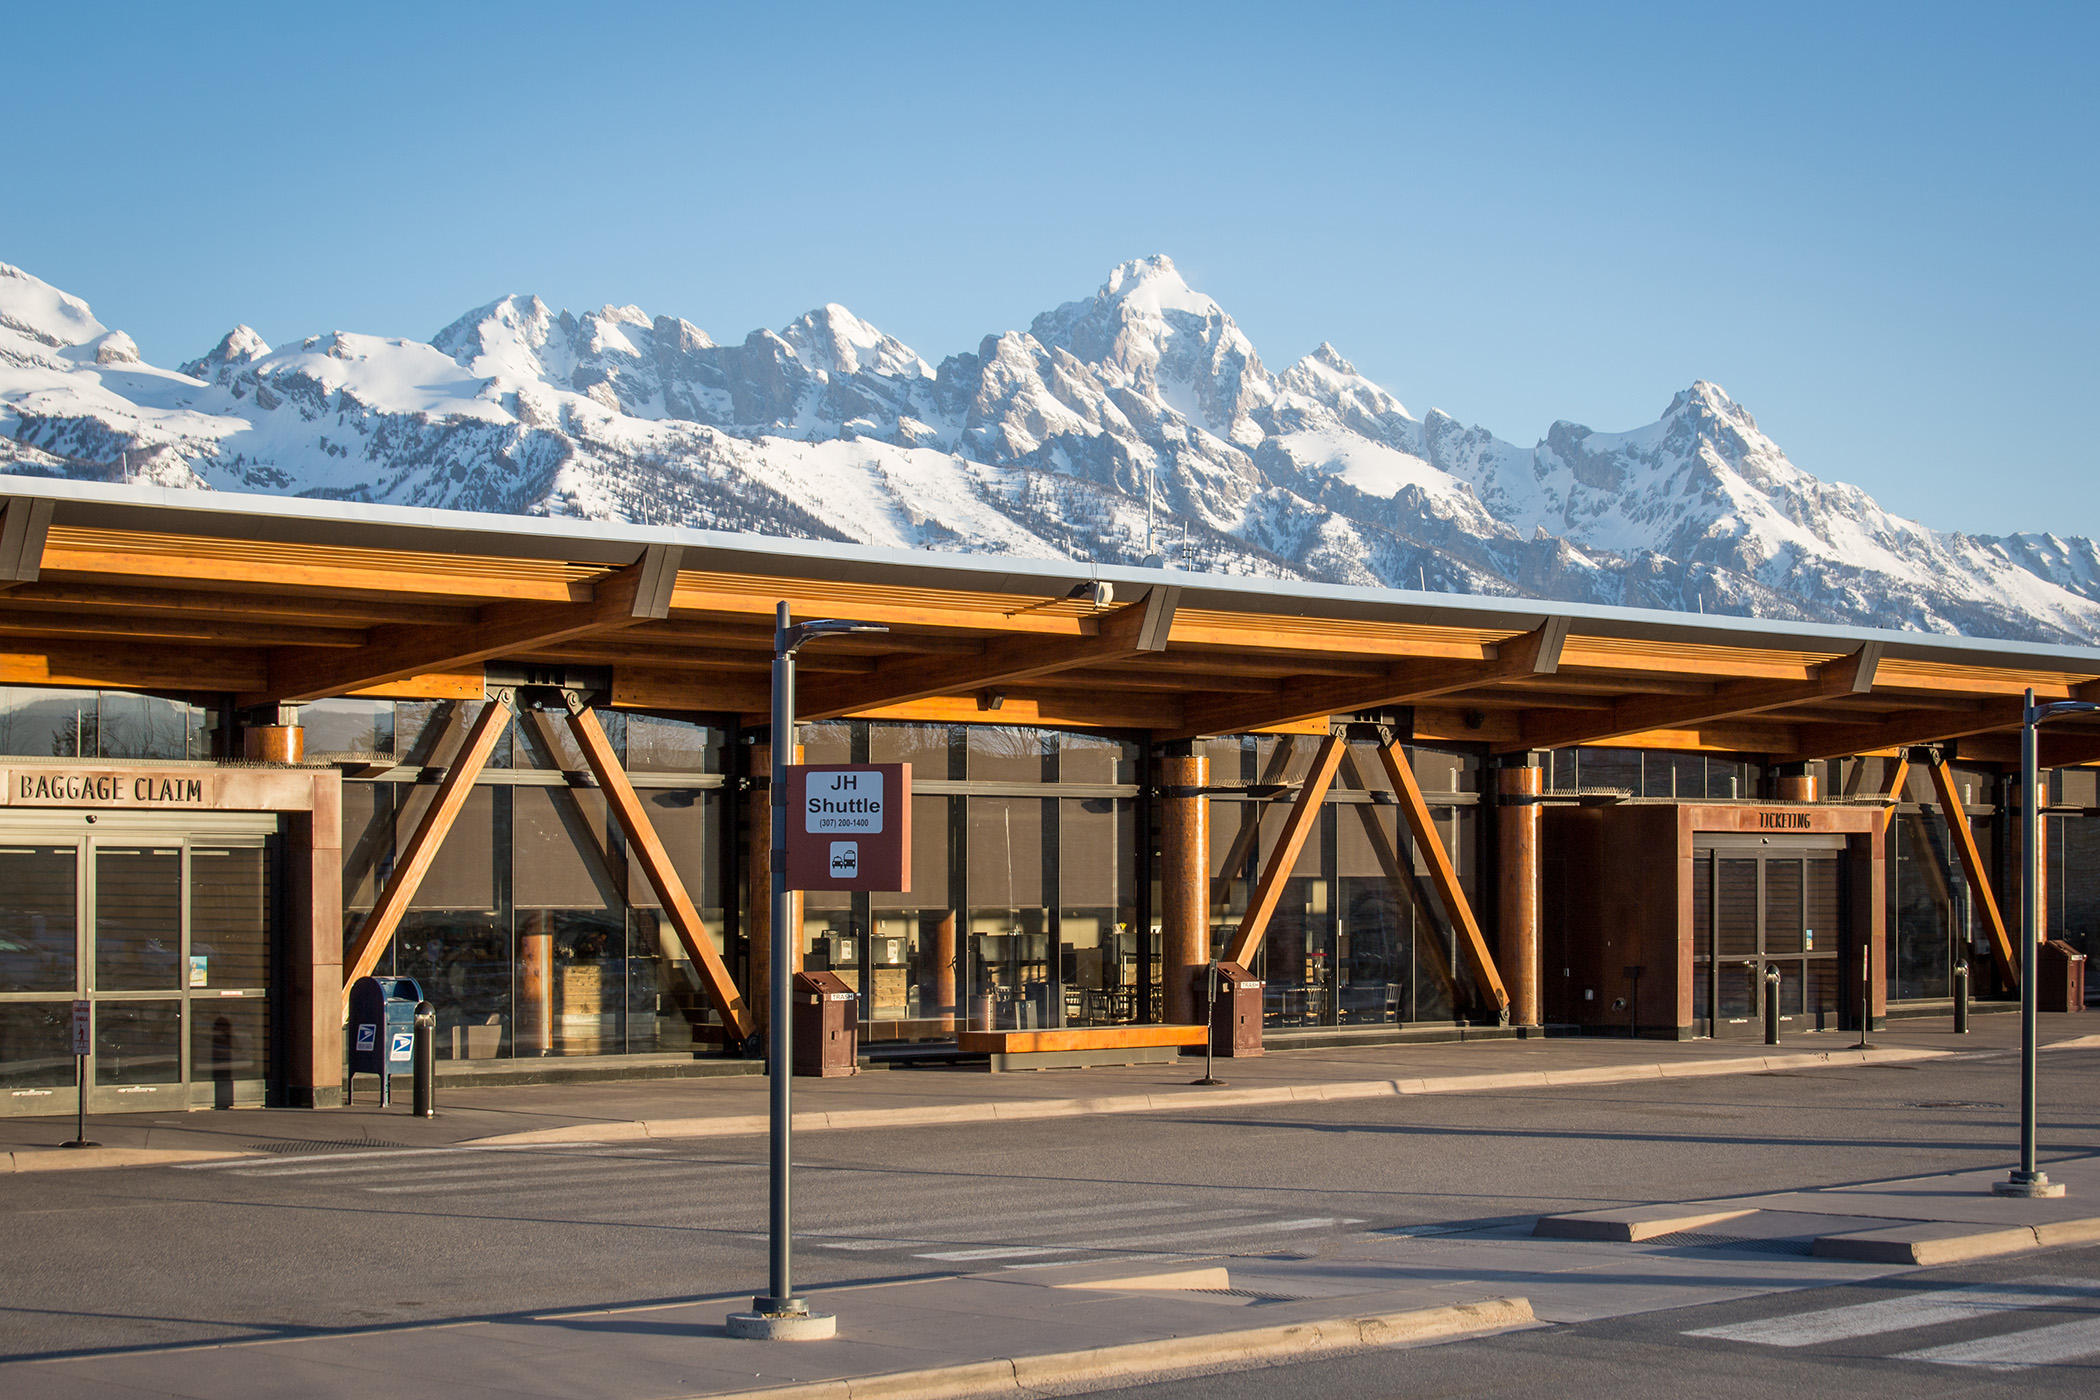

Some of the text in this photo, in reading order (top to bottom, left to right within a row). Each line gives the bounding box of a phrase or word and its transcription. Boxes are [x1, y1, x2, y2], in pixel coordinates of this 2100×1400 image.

[20, 775, 202, 802] BAGGAGE CLAIM
[830, 775, 857, 790] JH
[808, 798, 881, 813] Shuttle
[819, 819, 869, 828] (307) 200-1400
[1759, 812, 1811, 829] TICKETING
